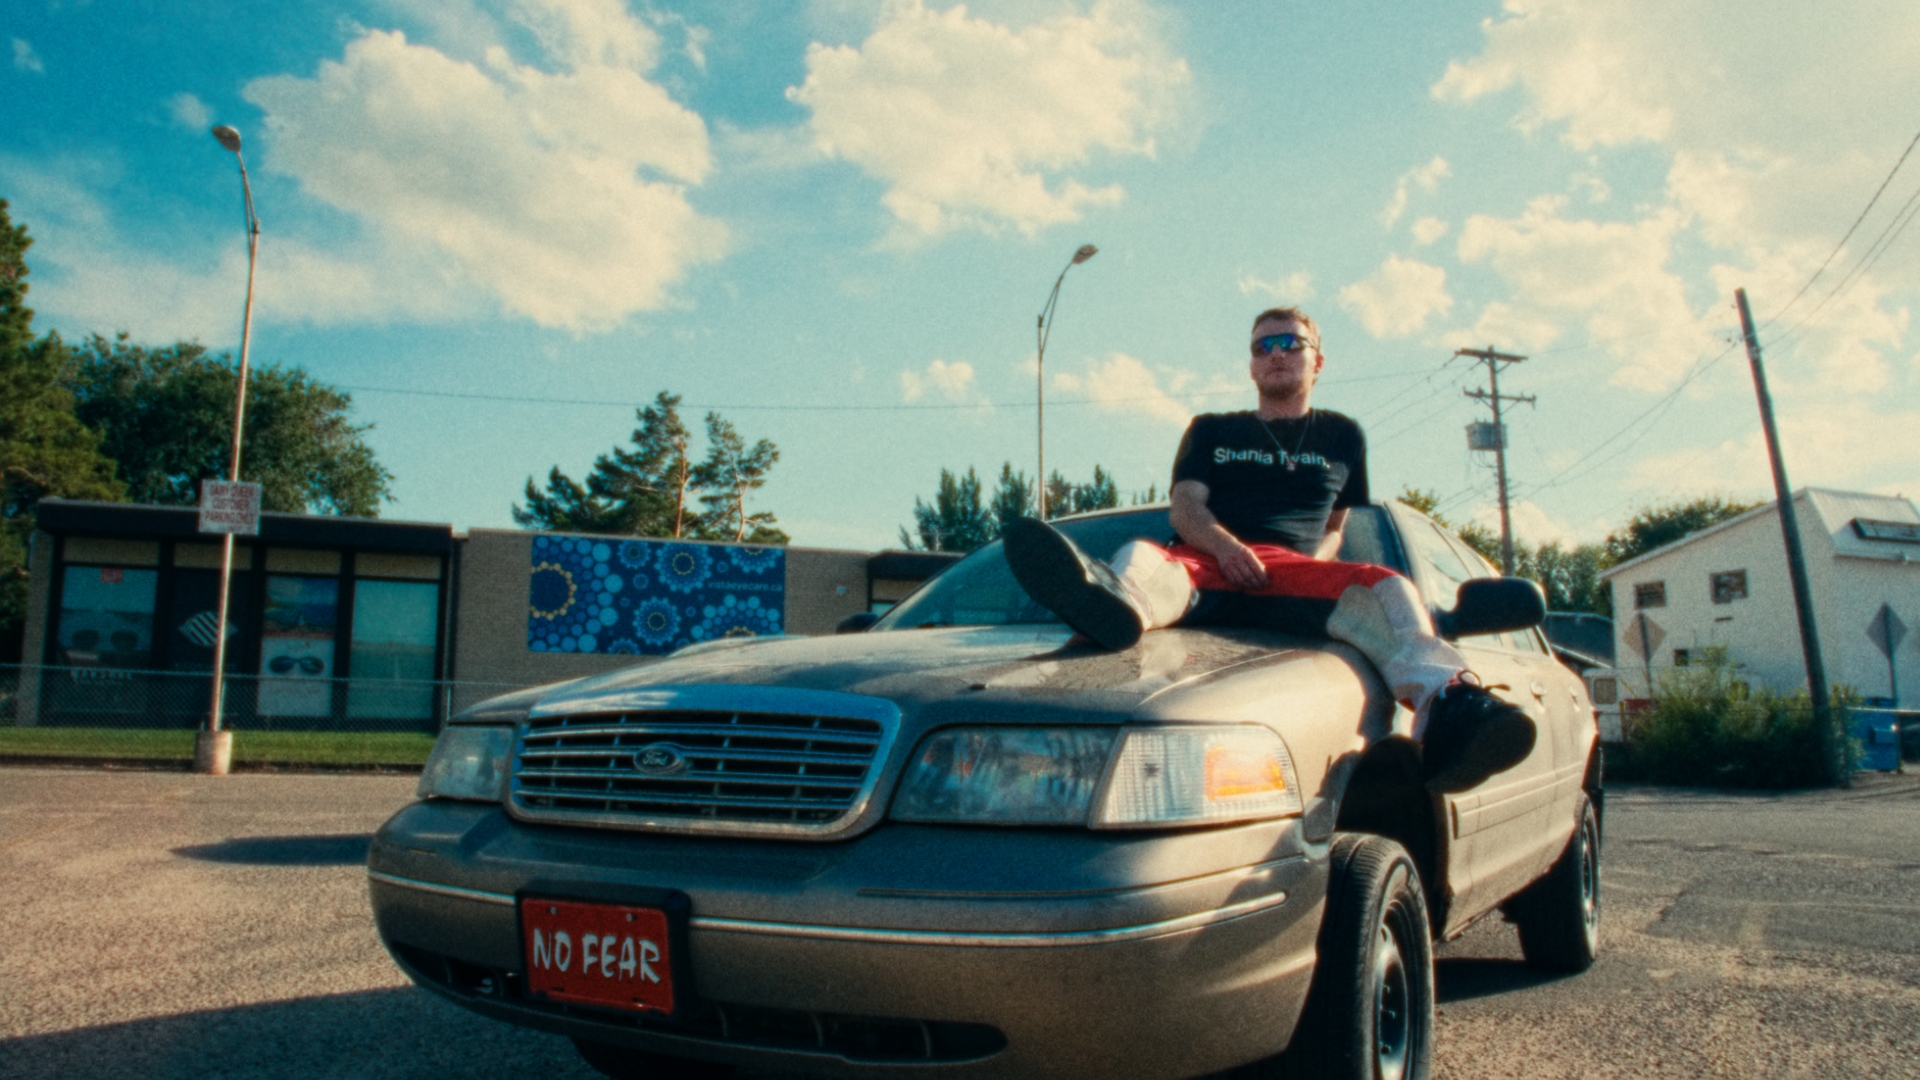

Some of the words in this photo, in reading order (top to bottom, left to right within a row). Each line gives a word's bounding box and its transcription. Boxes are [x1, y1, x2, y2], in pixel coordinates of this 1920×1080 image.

[1214, 448, 1273, 465] Shania
[1277, 450, 1326, 465] Twain
[212, 498, 250, 511] CUSTOMER
[205, 511, 236, 523] PARKING
[707, 580, 783, 592] vistaeyecare.ca
[642, 750, 668, 765] Ford
[533, 928, 572, 972] NO
[582, 932, 661, 984] FEAR
